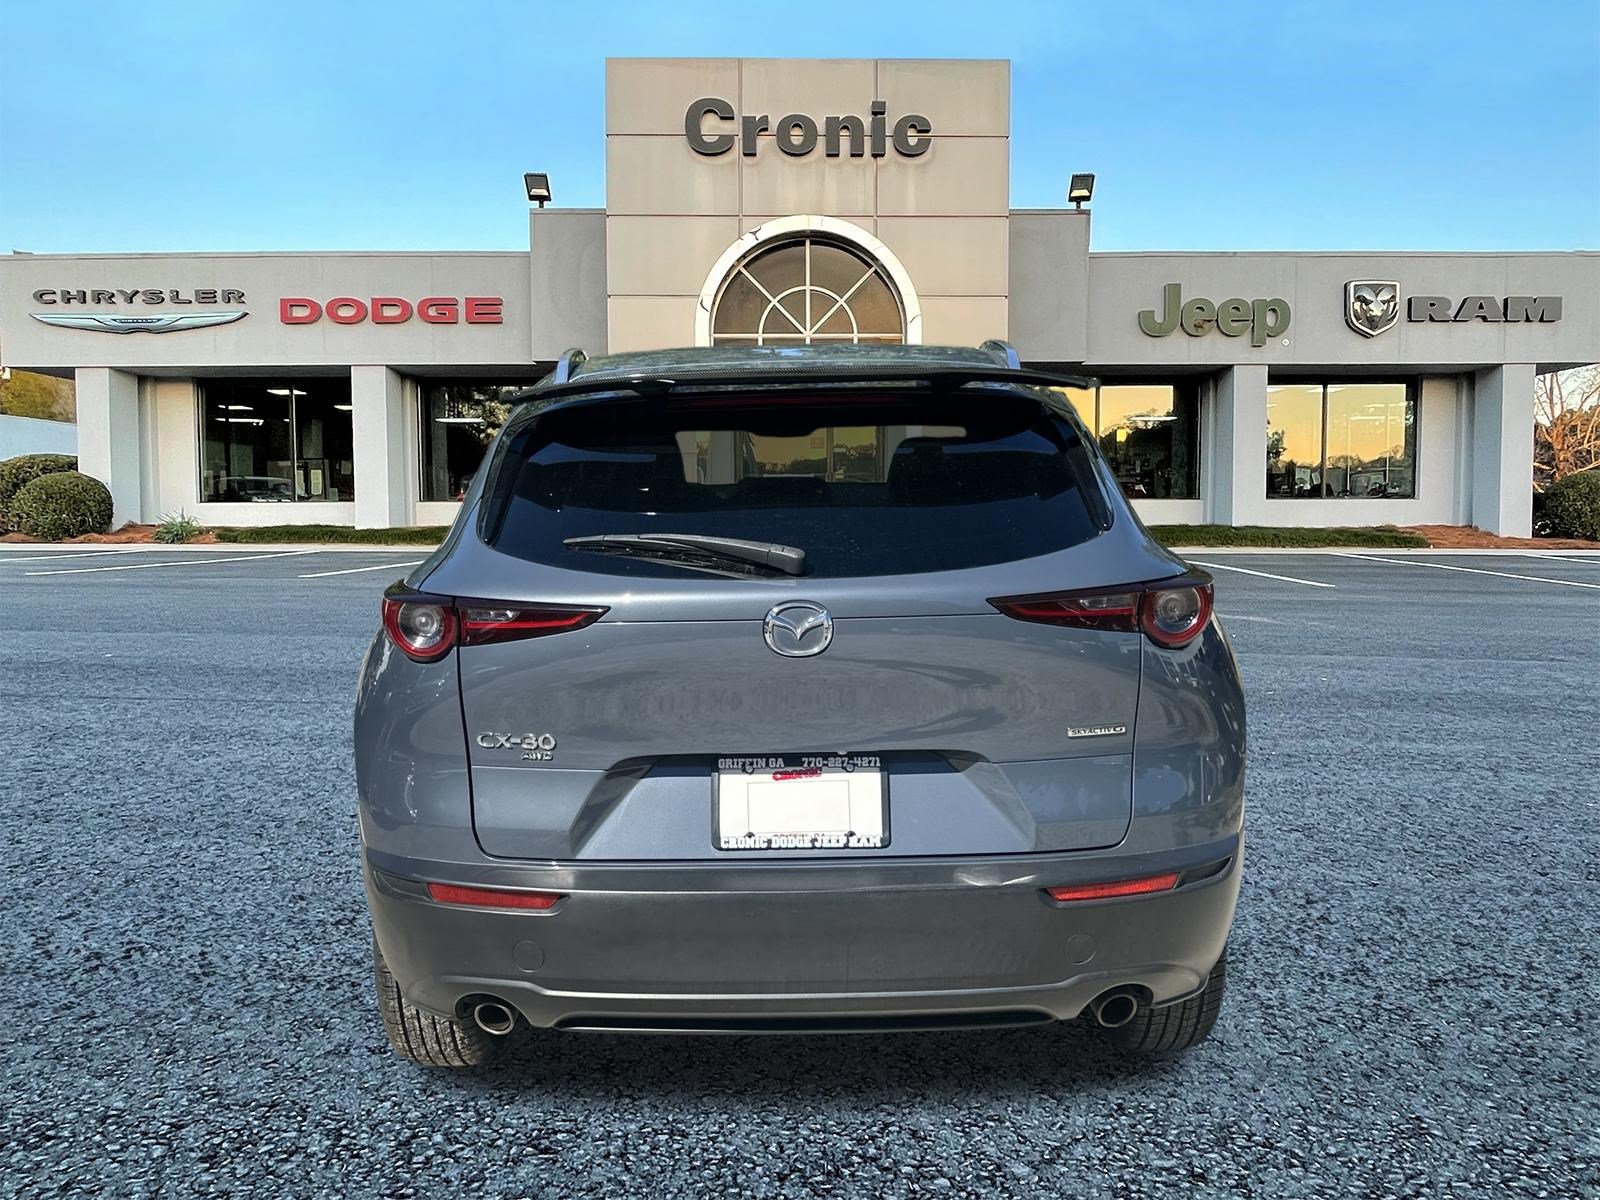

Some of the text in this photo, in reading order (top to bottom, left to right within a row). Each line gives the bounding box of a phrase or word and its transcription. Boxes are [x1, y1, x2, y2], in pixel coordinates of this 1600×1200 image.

[684, 97, 932, 157] Cronic
[32, 288, 246, 305] CHRYSLER
[280, 297, 504, 325] DODGE
[1138, 283, 1291, 347] Jeep
[1406, 296, 1563, 323] RAM
[476, 731, 555, 751] CX-30
[718, 756, 881, 769] GRIFFIN GA 770-227-4271
[720, 836, 768, 849] CRONIC
[771, 835, 812, 848] DODGE
[814, 835, 847, 848] JEEP
[849, 835, 882, 848] RAM
